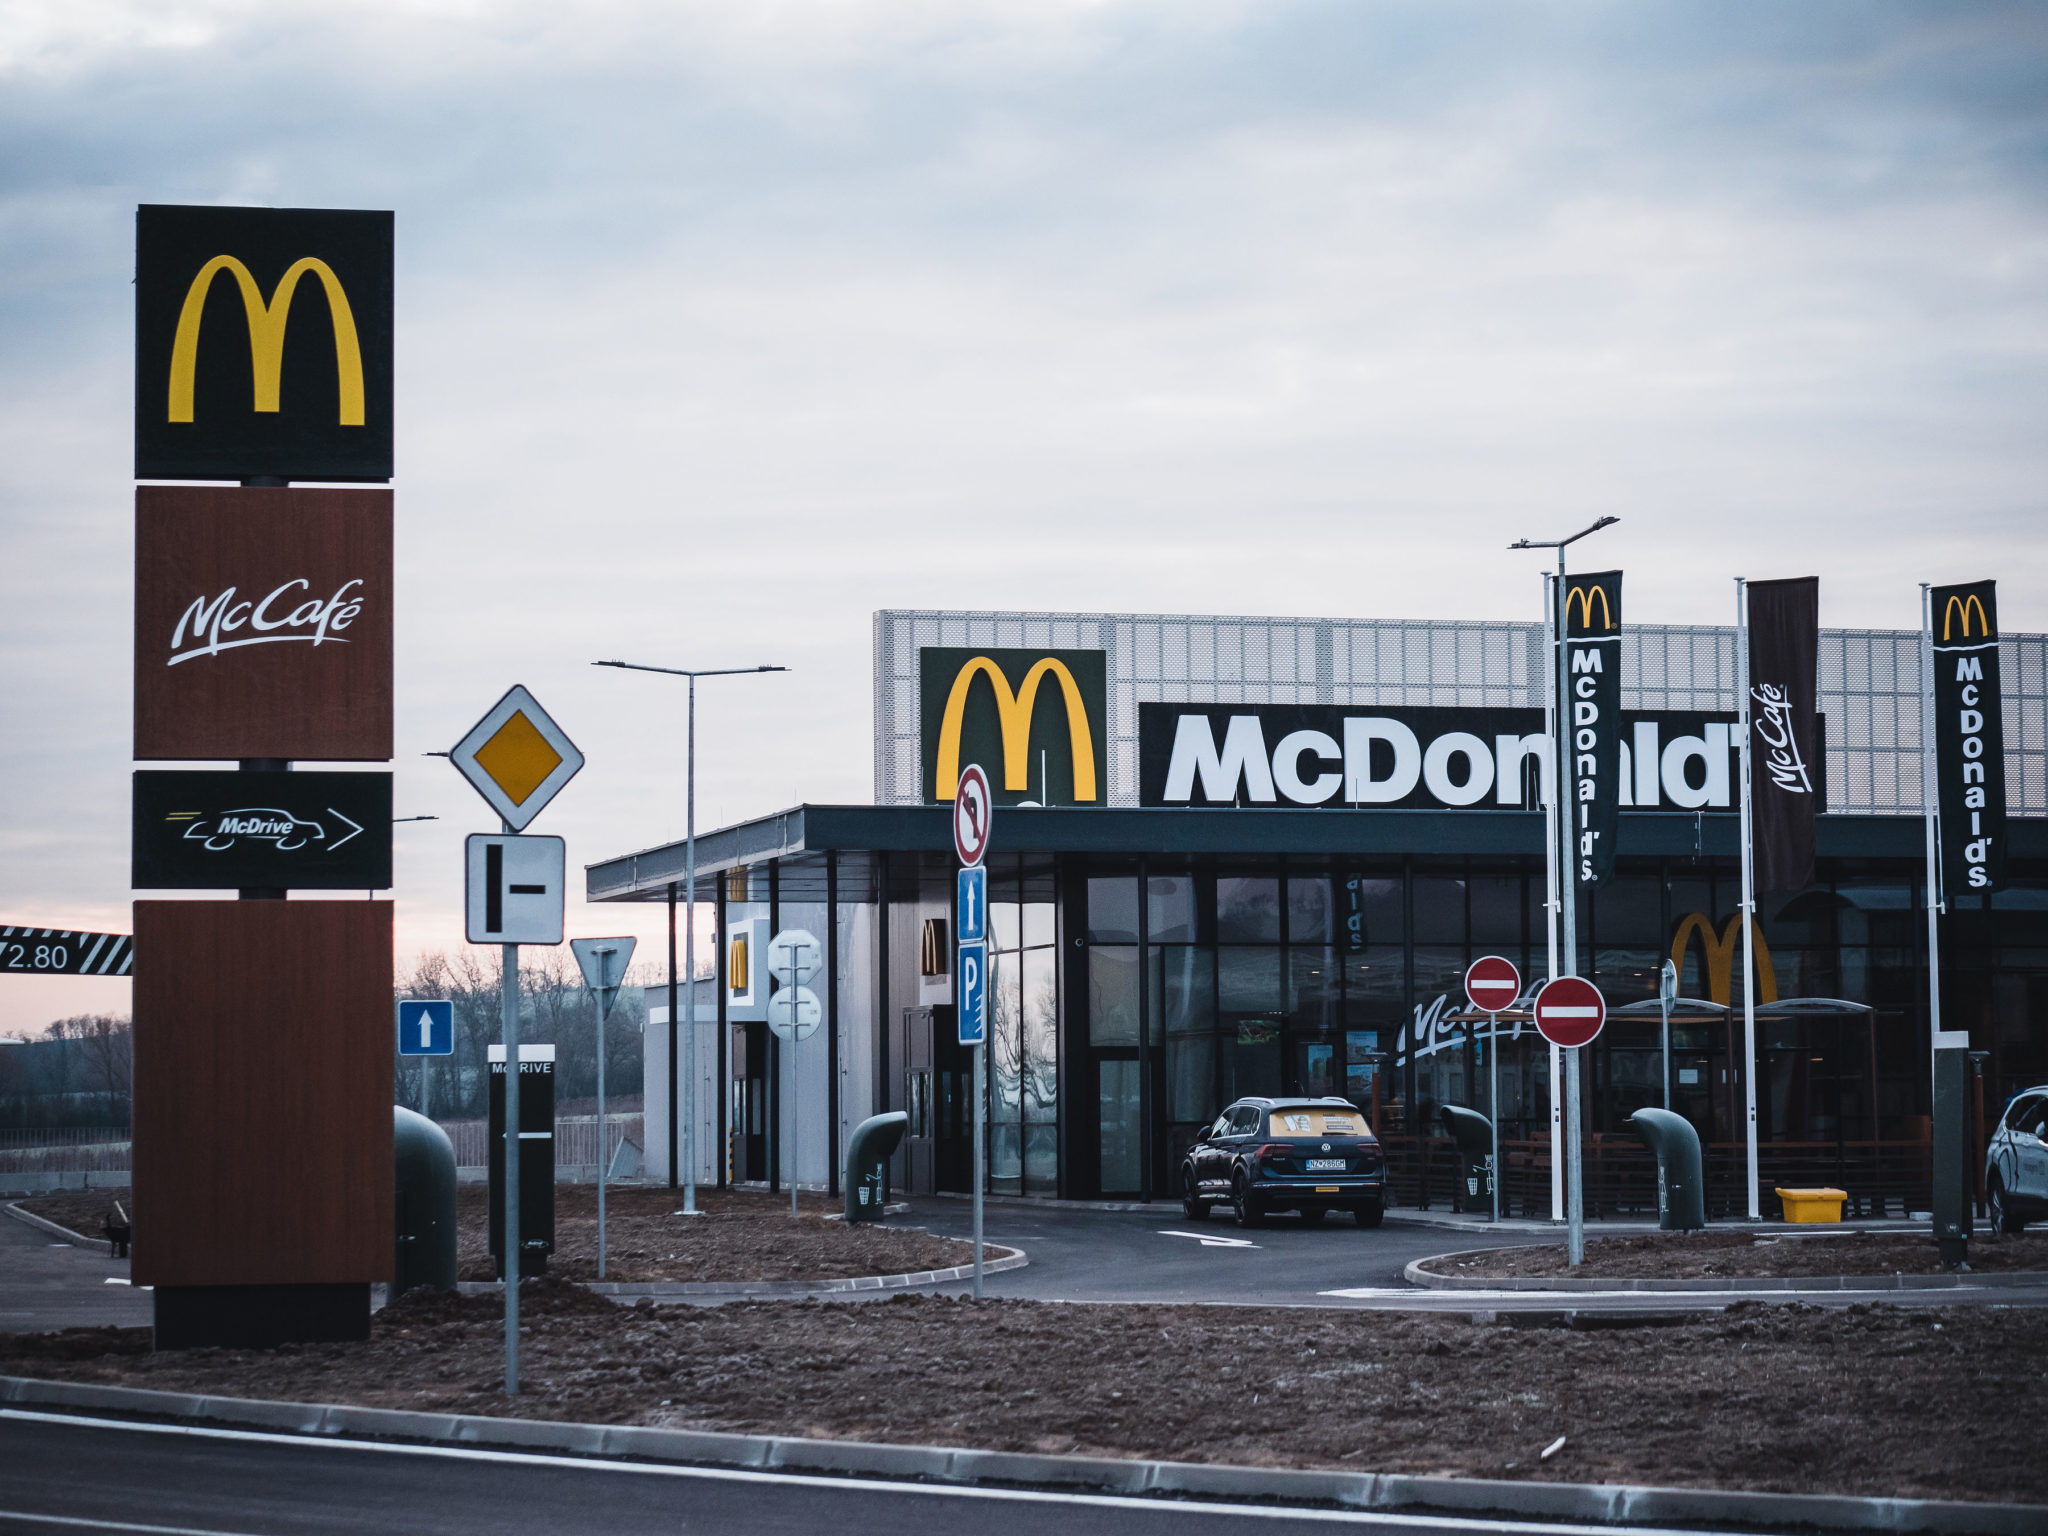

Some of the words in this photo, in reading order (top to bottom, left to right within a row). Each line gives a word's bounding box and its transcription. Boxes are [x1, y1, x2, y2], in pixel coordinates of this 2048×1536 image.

[168, 579, 364, 666] McCafé
[1750, 683, 1813, 793] McCafé
[1956, 656, 1993, 887] McDonald's
[217, 817, 294, 835] McDrive
[8, 944, 68, 969] 2.80
[965, 956, 978, 1012] P
